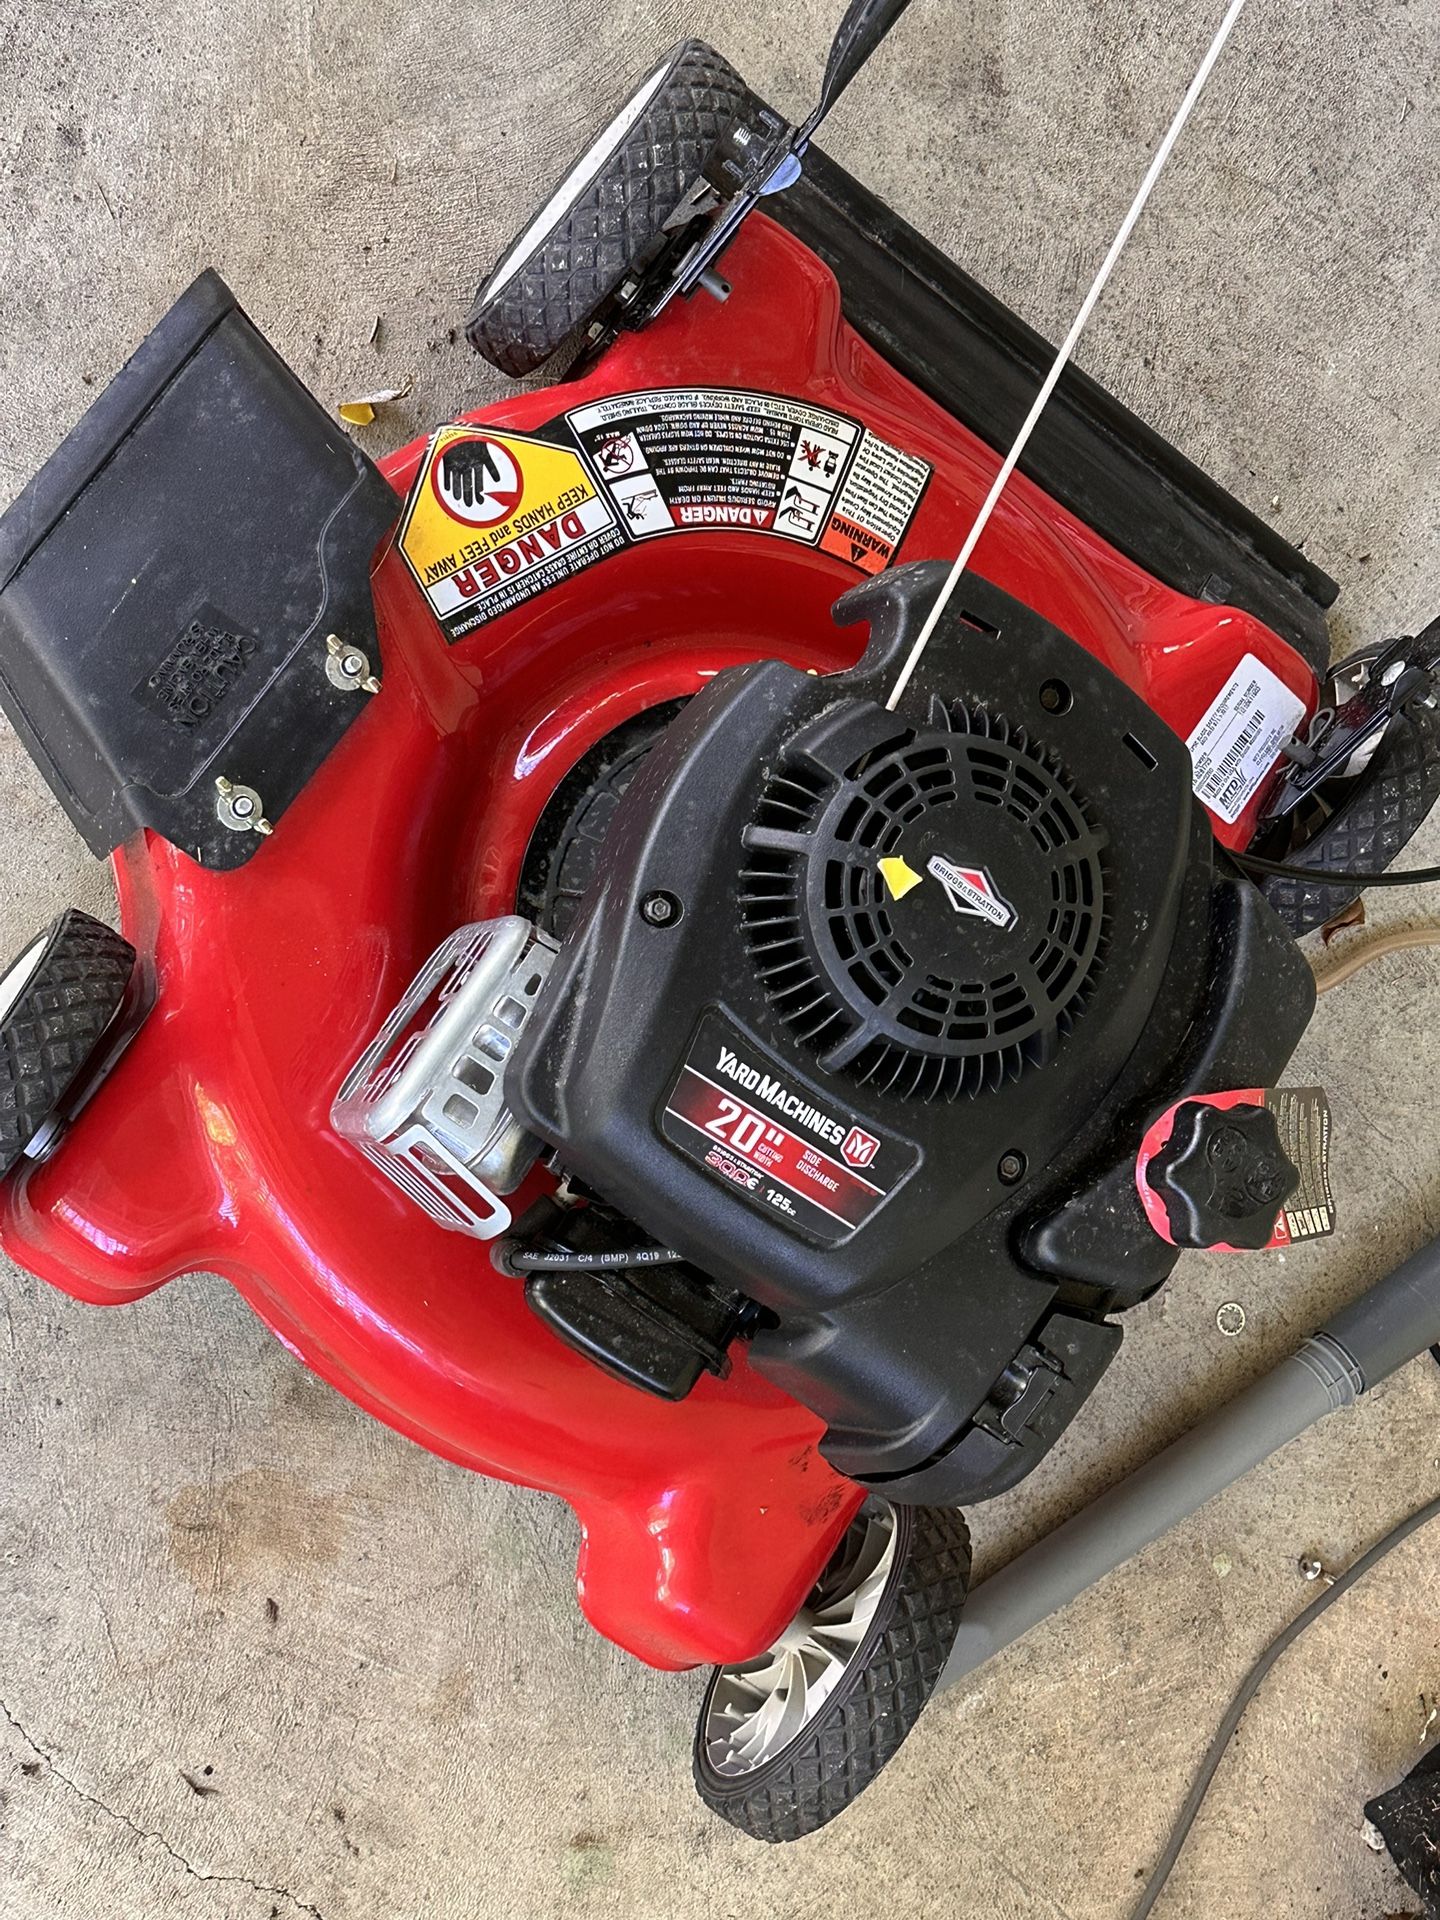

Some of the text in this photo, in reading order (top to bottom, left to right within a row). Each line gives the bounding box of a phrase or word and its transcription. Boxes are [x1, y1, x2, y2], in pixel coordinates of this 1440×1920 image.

[635, 396, 661, 406] REPLACE
[723, 402, 744, 410] SAFETY
[744, 397, 762, 407] PLACE
[621, 405, 646, 415] TRAILING
[745, 405, 760, 414] KEEP
[741, 417, 761, 426] BEFORE
[761, 420, 780, 429] BEHIND
[807, 412, 839, 428] DISCHARGE
[636, 424, 652, 433] DOWN
[661, 430, 679, 438] SLOPES
[775, 430, 790, 438] THAN
[822, 424, 838, 435] READ
[742, 433, 763, 442] CAUTION
[863, 437, 873, 447] Fire
[708, 444, 733, 452] CHILDREN
[879, 446, 899, 462] Relating
[733, 467, 756, 476] OBJECTS
[757, 470, 779, 479] REMOVE
[854, 460, 878, 479] Operator
[858, 453, 919, 494] Should Contact Local Fire
[870, 450, 922, 487] Agencies For Laws
[898, 458, 925, 479] Regulations
[748, 480, 775, 489] ROTATING
[860, 474, 871, 487] May
[877, 475, 889, 486] The
[740, 487, 760, 495] HANDS
[726, 496, 755, 505] SERIOUS
[756, 499, 775, 507] AVOID
[844, 487, 904, 526] Sparks That Can Start Fires
[878, 494, 889, 507] Dry
[892, 493, 907, 507] Spark
[679, 507, 750, 523] DANGER
[840, 496, 901, 535] Equipment May Create
[888, 502, 908, 518] Around
[841, 506, 896, 541] Operation Of This
[422, 484, 589, 582] KEEP HANDS and FEET AWAY
[829, 517, 891, 558] WARNING
[451, 510, 586, 600] DANGER
[474, 527, 620, 612] COVER OR ENTIRE GRASS CATCHER IS IN PLACE.
[450, 535, 624, 637] DO NOT OPERATE UNLESS AN UNDAMAGED DISCHARGE
[174, 638, 256, 727] CAUTION
[1205, 711, 1219, 728] SAFETY
[1217, 778, 1240, 806] MTD
[933, 862, 1003, 919] BRIGGS&STRATTON
[711, 1047, 847, 1146] YARD MACHINES
[704, 1098, 784, 1154] 20"
[752, 1150, 773, 1167] WIDTH
[757, 1142, 783, 1163] CUTTING
[802, 1149, 822, 1167] SIDE
[795, 1159, 839, 1193] DISCHARGE
[764, 1188, 796, 1216] 125cc
[636, 1252, 659, 1260] 4Q19
[667, 1250, 681, 1258] 12
